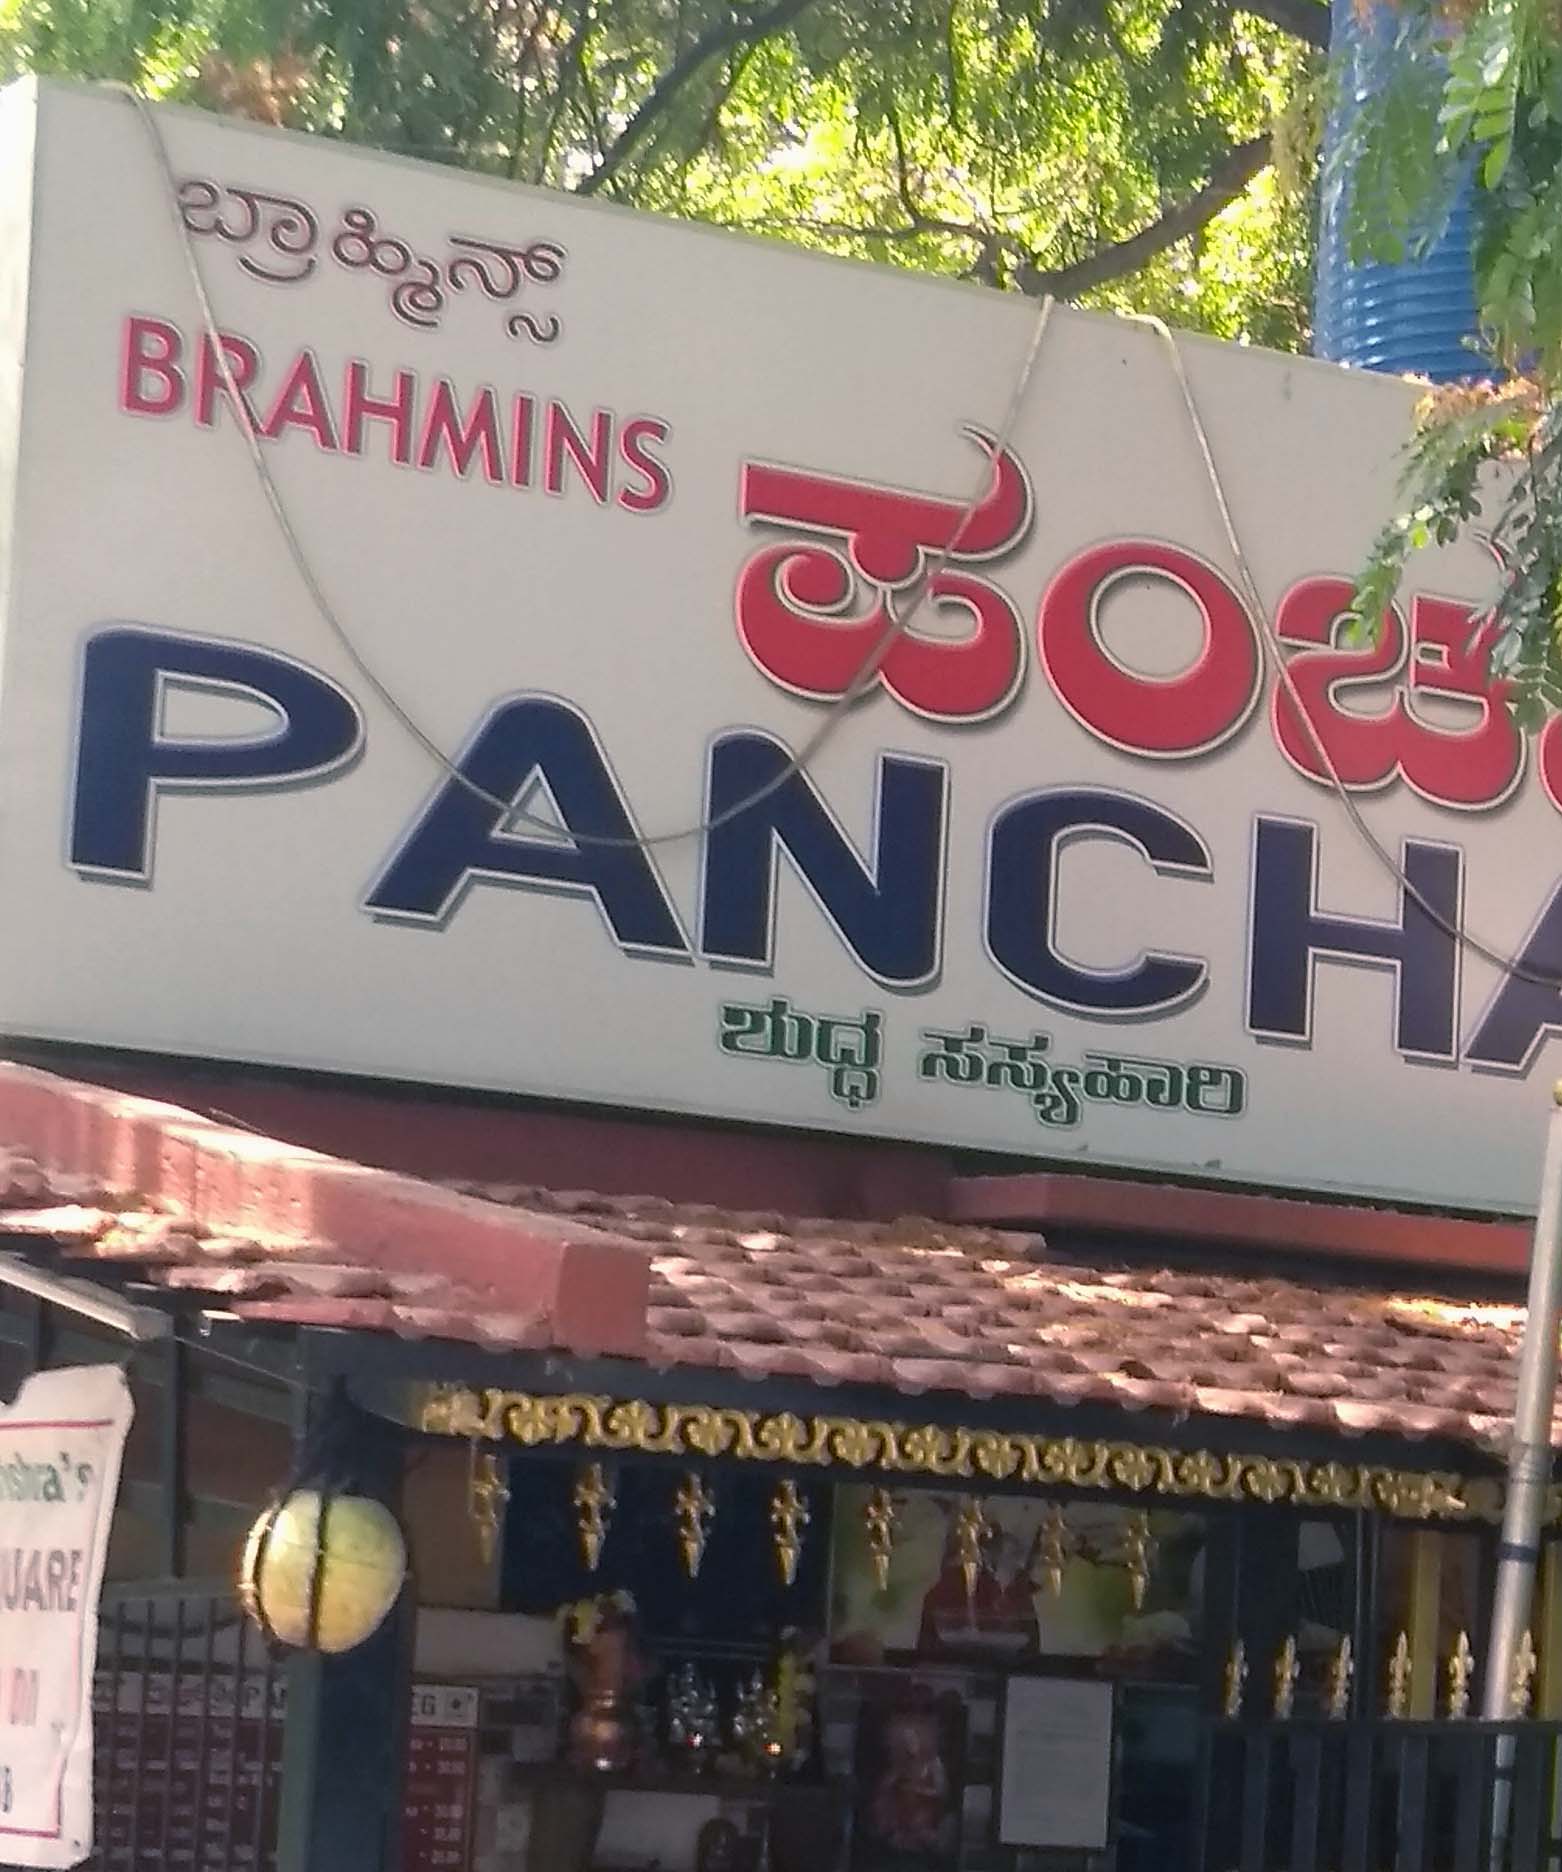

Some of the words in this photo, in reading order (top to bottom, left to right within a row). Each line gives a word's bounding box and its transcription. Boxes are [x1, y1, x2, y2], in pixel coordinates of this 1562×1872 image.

[118, 314, 672, 513] BRAHMINS
[720, 997, 882, 1110] ಶುದ್ಧ
[0, 1549, 82, 1612] UARE
